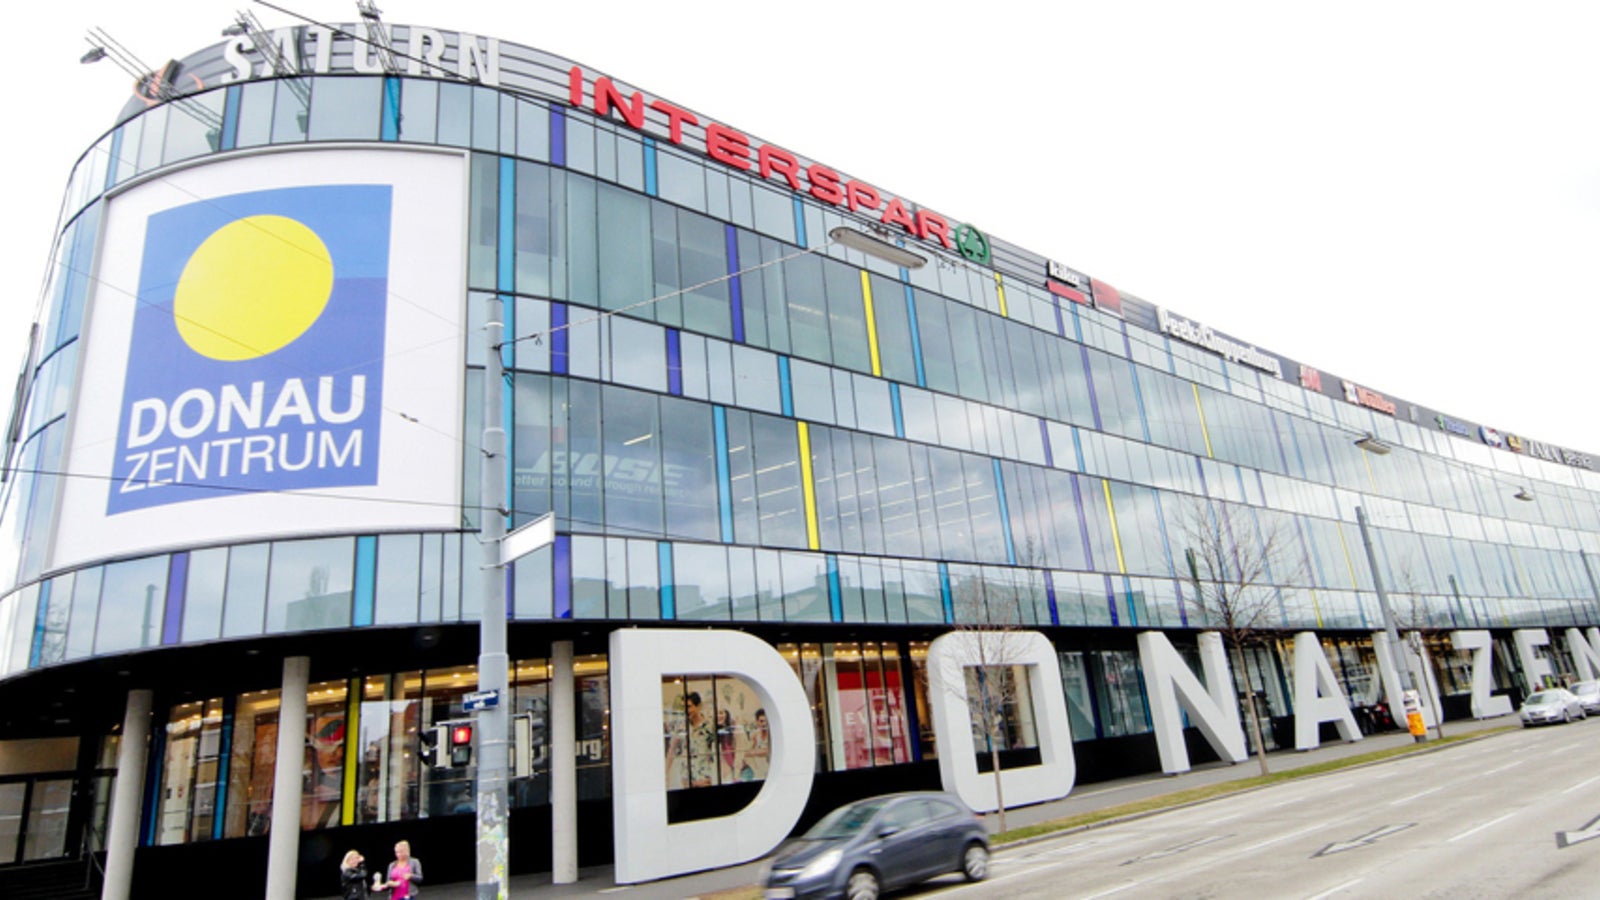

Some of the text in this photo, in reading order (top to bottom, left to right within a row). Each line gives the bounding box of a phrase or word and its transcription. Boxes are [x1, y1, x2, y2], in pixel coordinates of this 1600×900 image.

[221, 24, 499, 86] SATURN
[569, 66, 951, 248] INTERSPAR
[127, 375, 366, 449] DONAU
[119, 429, 363, 494] ZENTRUM
[526, 450, 690, 486] BOSE
